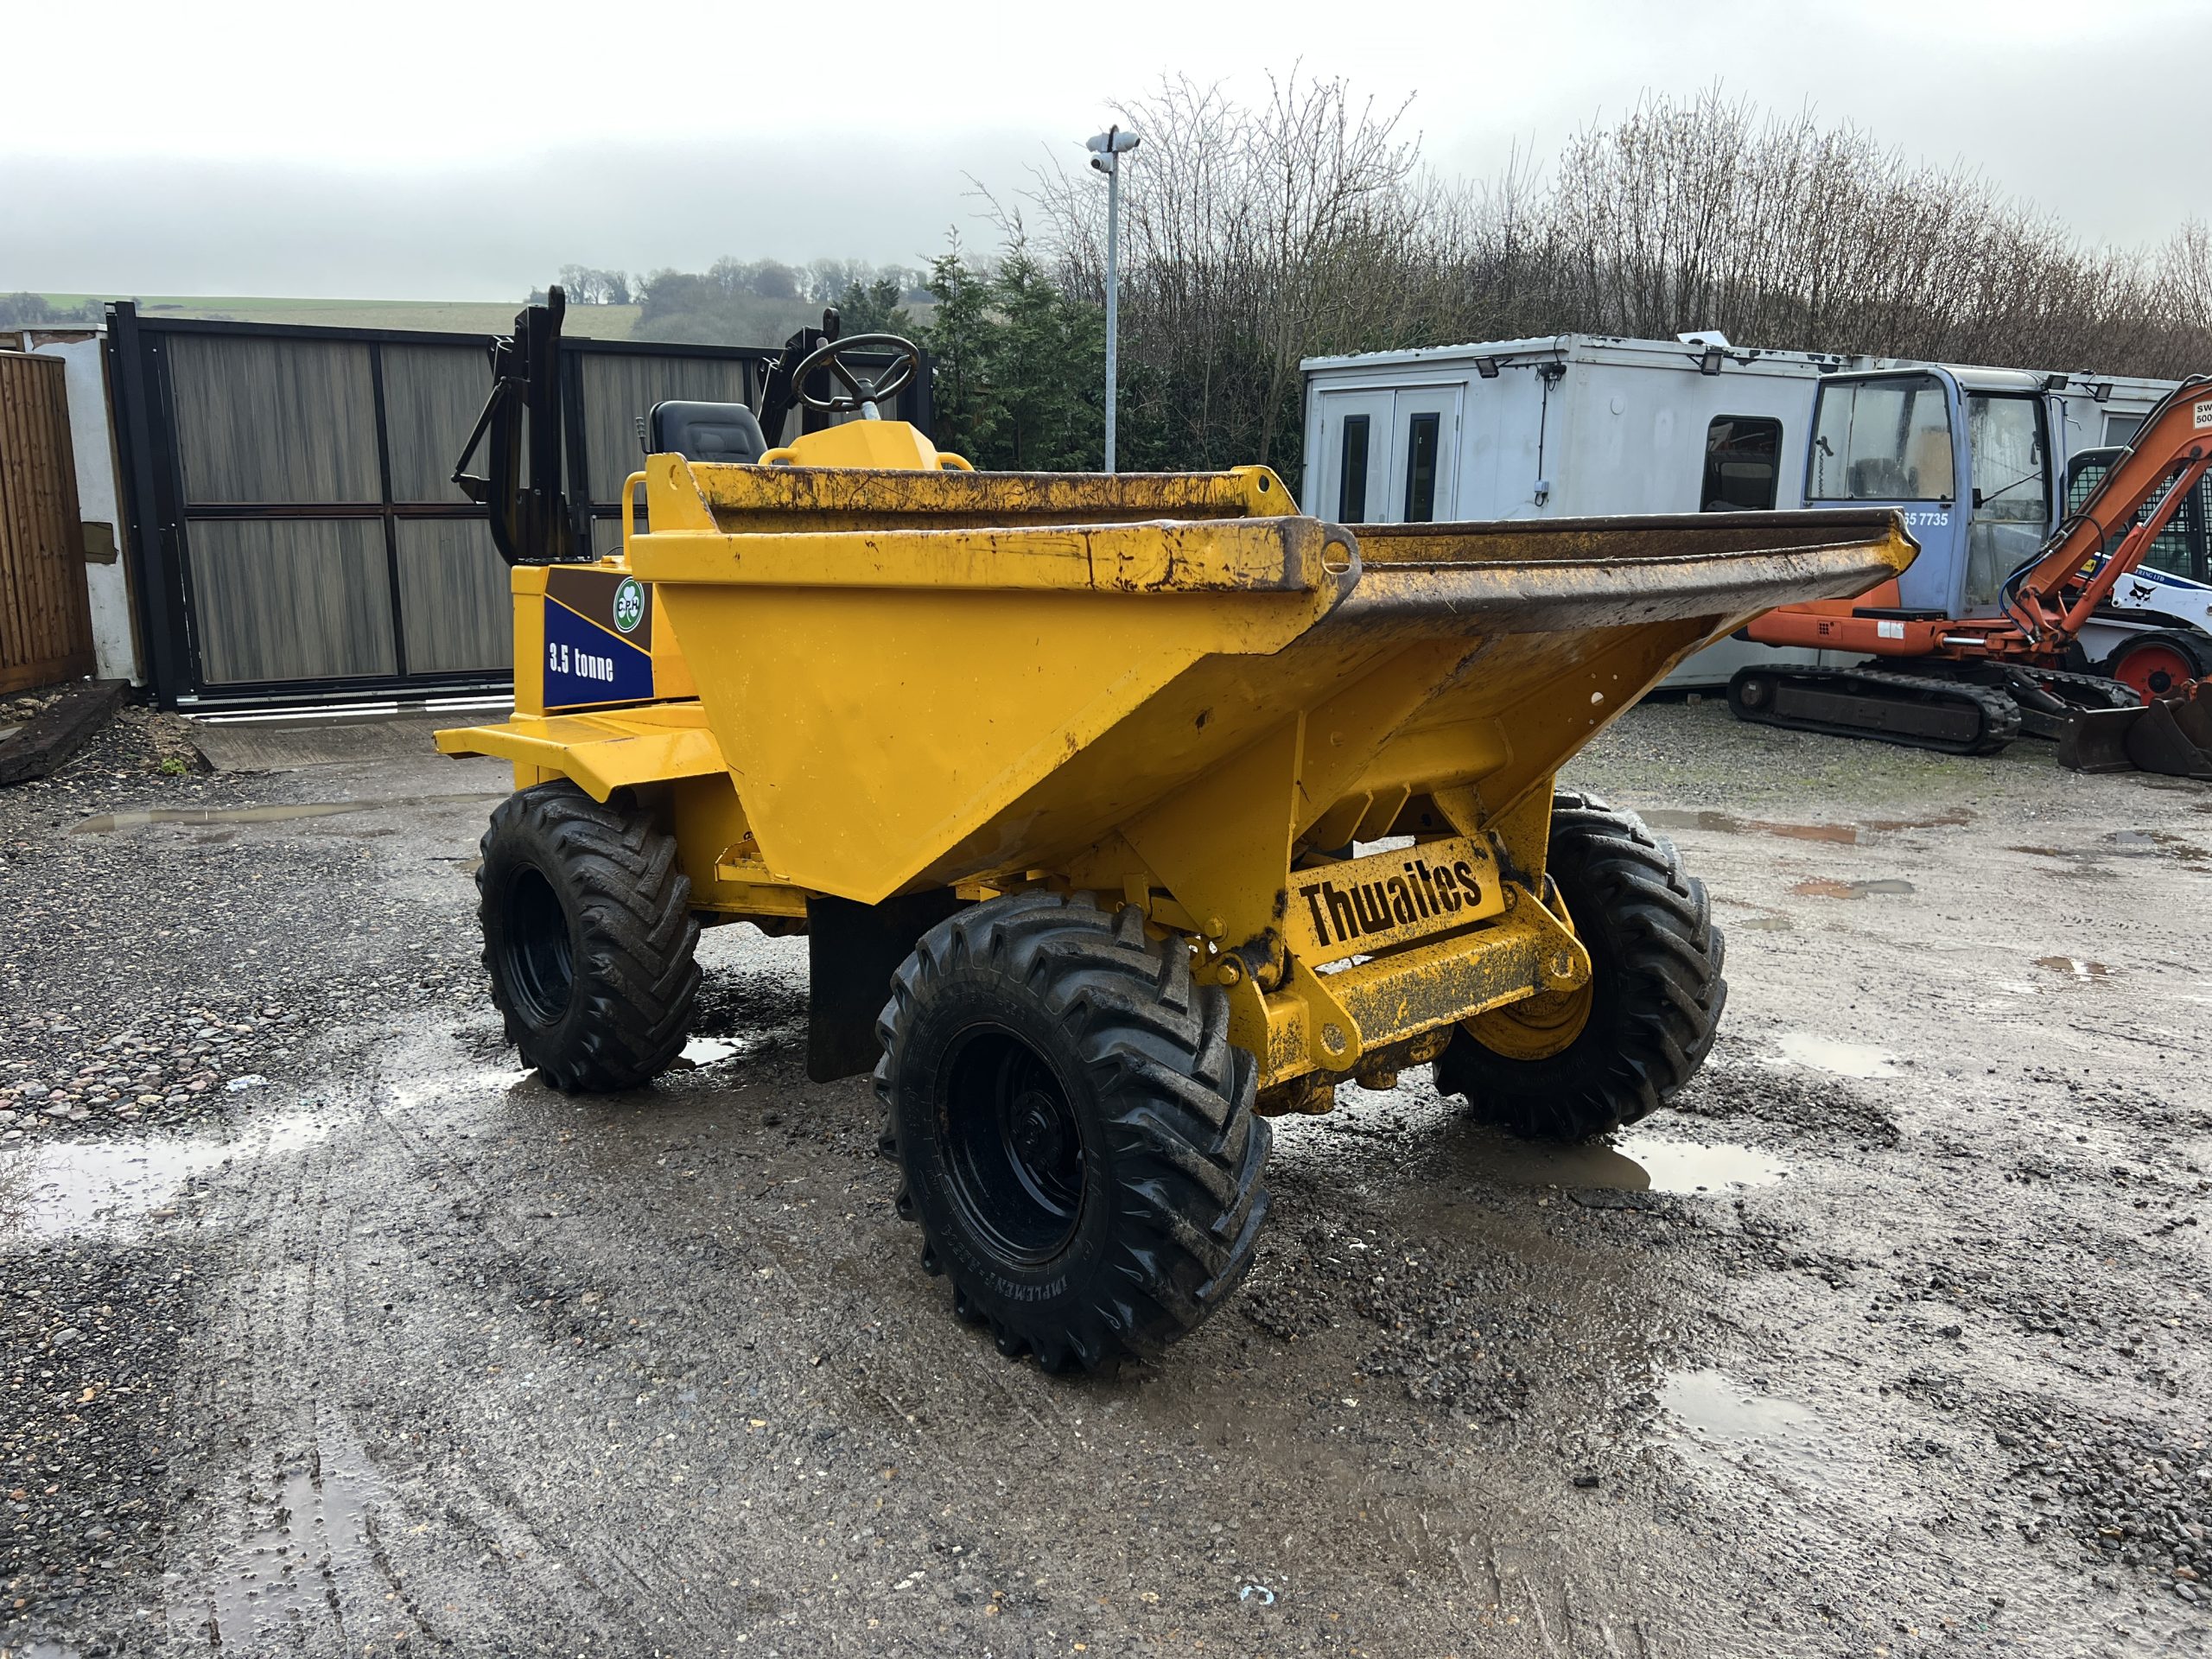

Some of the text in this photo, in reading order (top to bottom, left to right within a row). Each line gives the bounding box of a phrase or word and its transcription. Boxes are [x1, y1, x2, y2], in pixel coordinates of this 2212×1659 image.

[1919, 512, 1948, 526] 7735
[550, 642, 613, 683] 3.5 tonne
[1299, 860, 1482, 947] Thwaites
